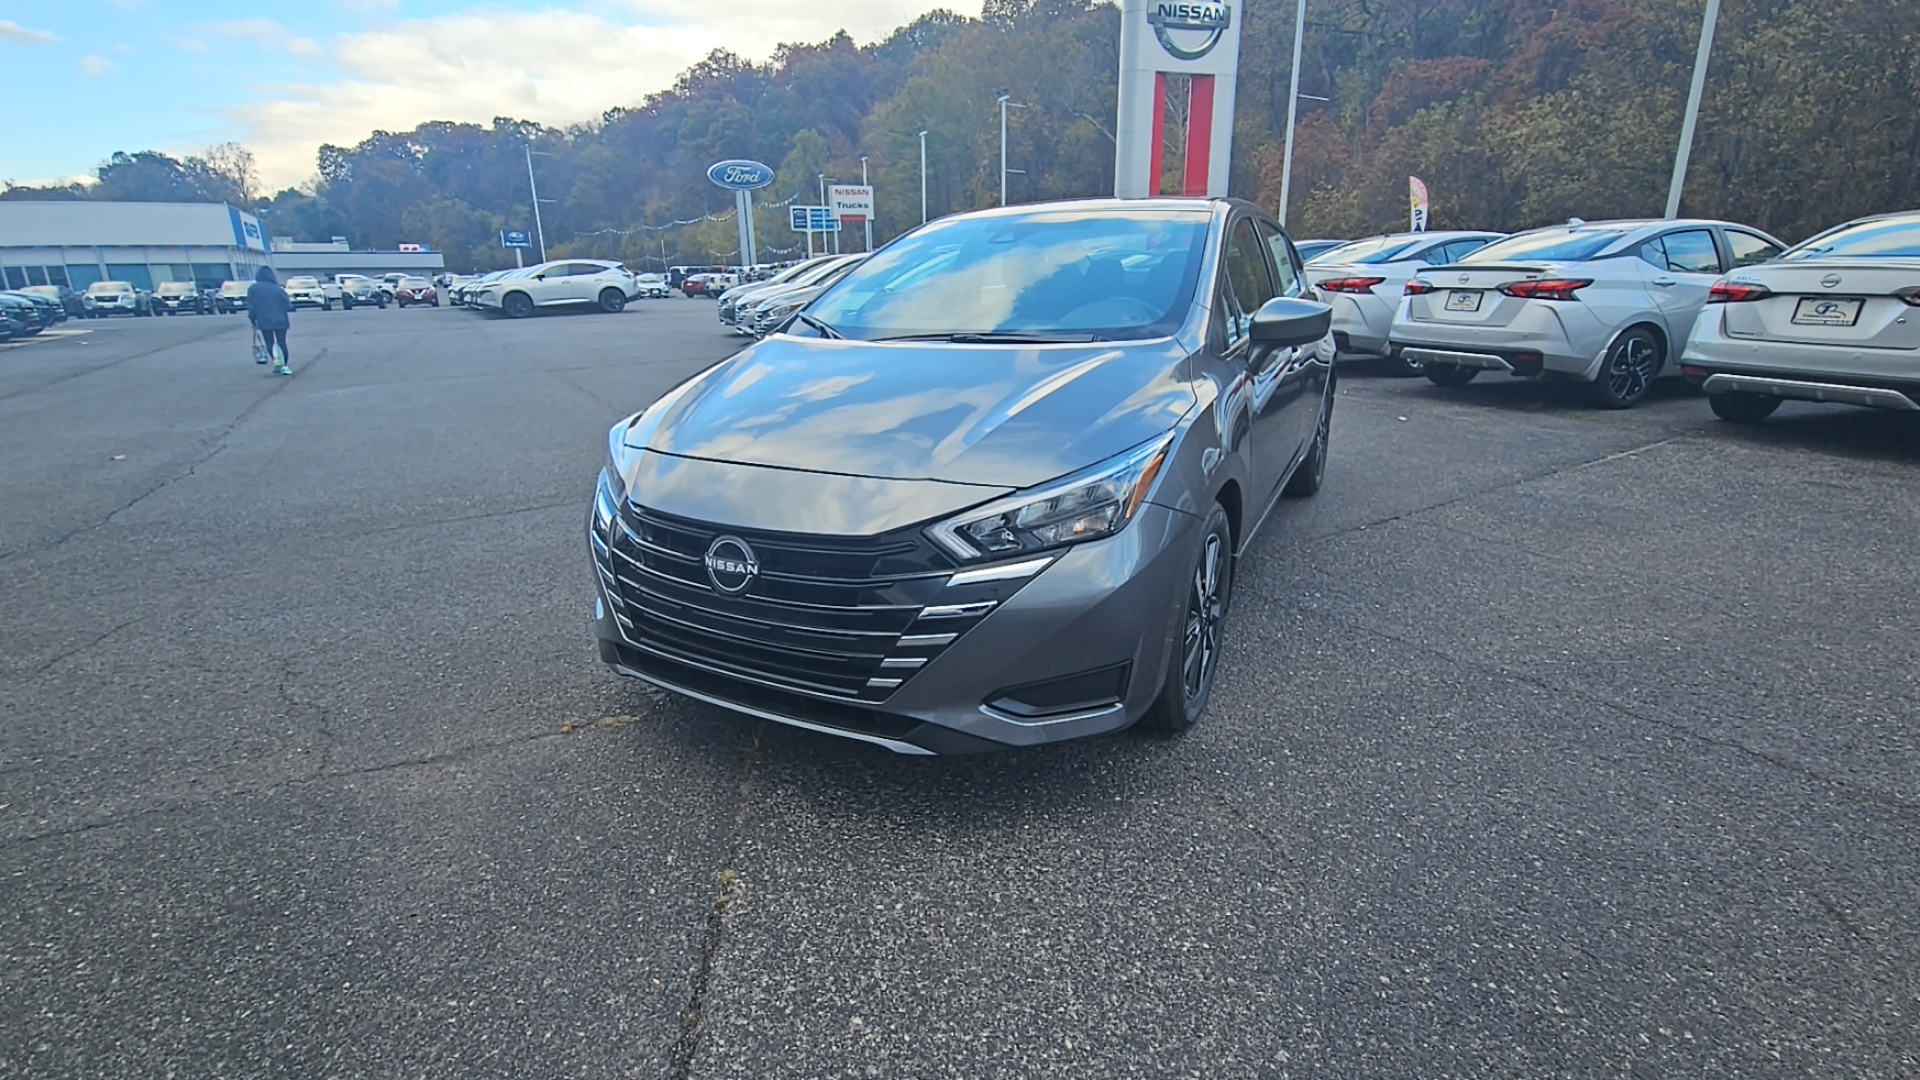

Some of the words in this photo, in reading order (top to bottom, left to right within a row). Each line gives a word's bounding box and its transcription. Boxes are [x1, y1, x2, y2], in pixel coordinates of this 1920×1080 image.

[1158, 4, 1225, 21] NISSAN
[724, 166, 760, 183] Ford
[705, 555, 758, 574] NISSAN
